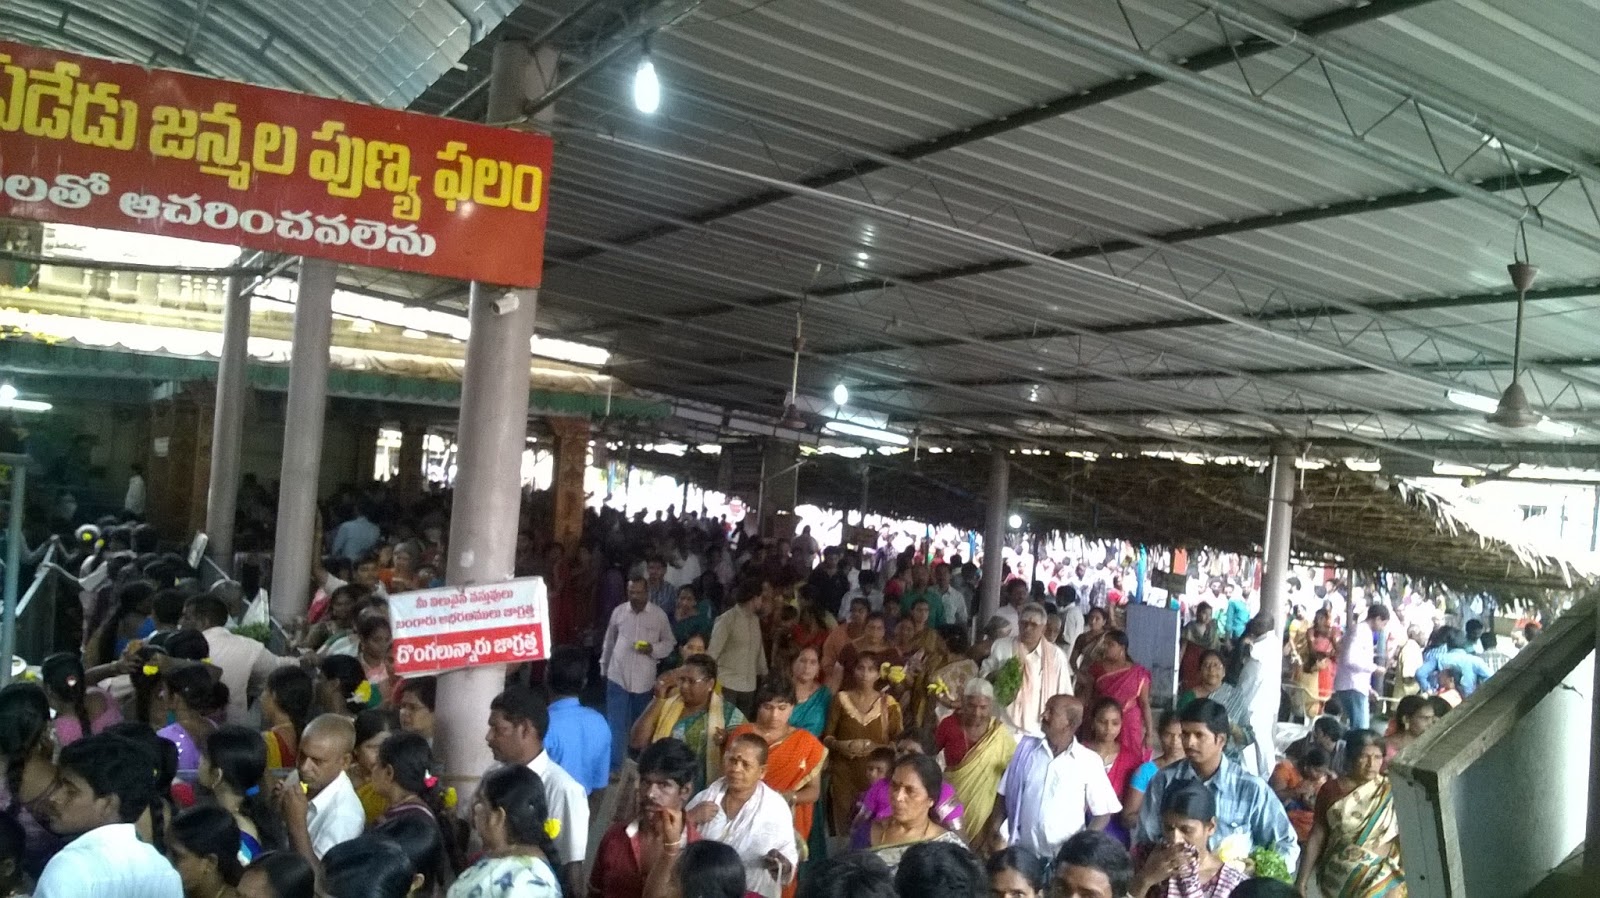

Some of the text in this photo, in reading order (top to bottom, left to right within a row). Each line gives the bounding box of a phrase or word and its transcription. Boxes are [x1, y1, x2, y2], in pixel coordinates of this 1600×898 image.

[150, 102, 298, 191] జన్మల
[309, 120, 421, 221] పుణ్య
[433, 141, 543, 212] ఫలం
[0, 172, 437, 257] లతో ఆచరించవలెను
[397, 631, 539, 664] దొంగలున్నారు జాగ్రత్త
